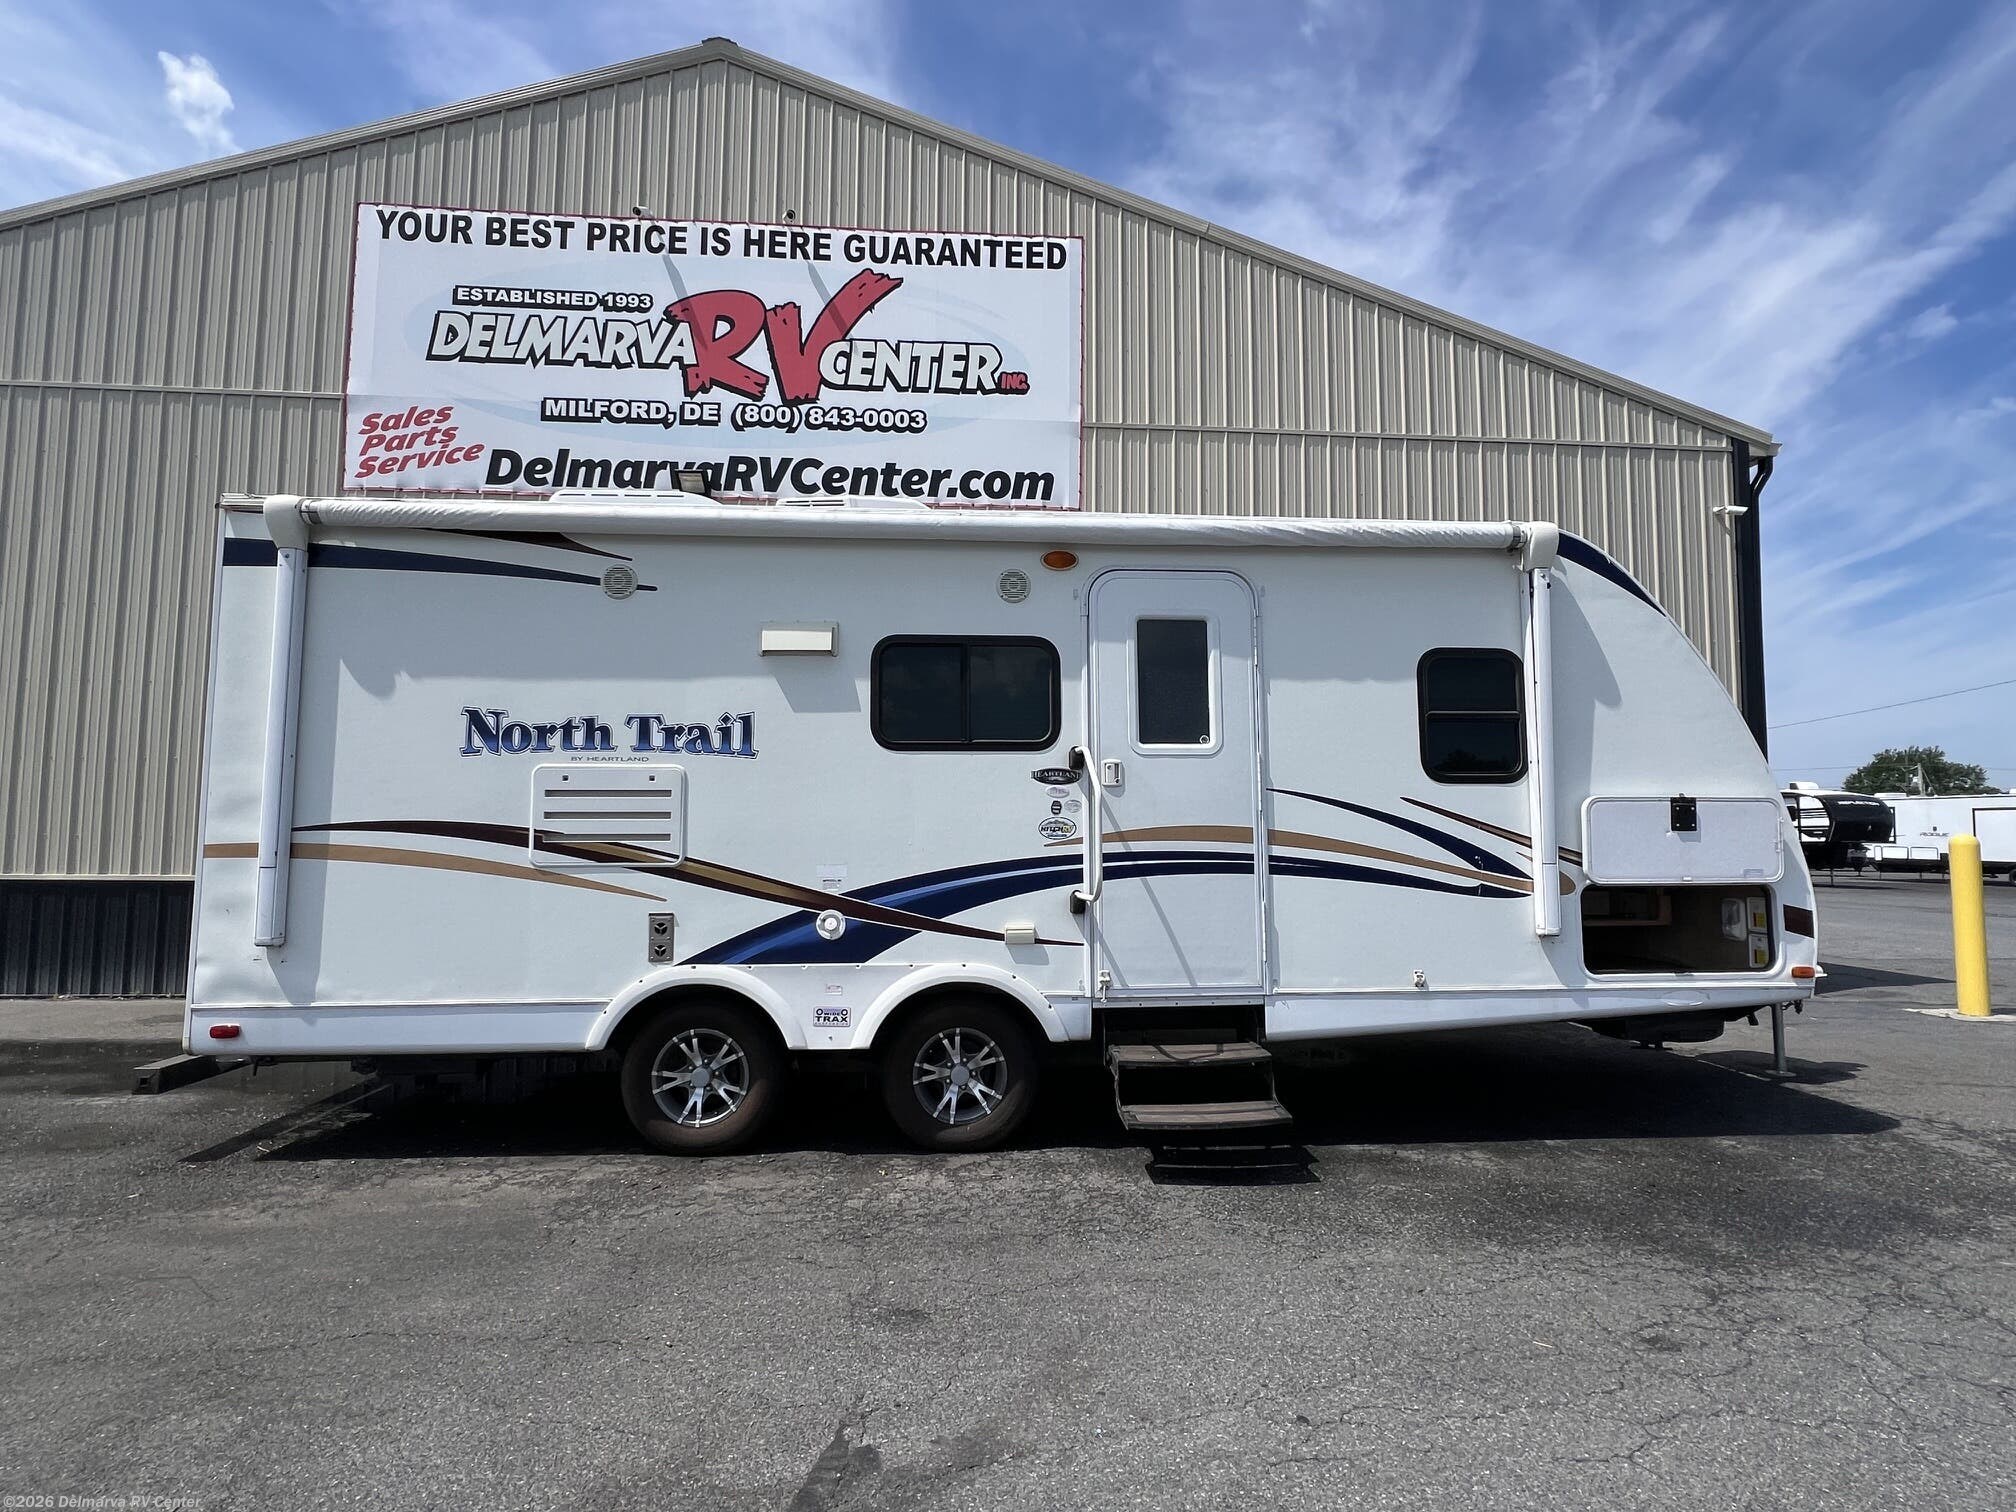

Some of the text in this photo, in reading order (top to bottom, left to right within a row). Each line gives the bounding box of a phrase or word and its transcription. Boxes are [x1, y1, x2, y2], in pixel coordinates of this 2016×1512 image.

[376, 209, 1067, 270] YOUR BEST PRICE IS HERE GUARANTEED
[455, 286, 653, 311] ESTABLISHED 1993
[426, 310, 699, 370] DELMARVA
[663, 267, 904, 406] RV
[818, 338, 1004, 396] CENTER
[358, 405, 455, 435] Sales
[544, 398, 927, 433] MILFORD, DE (800) 843-0003
[359, 425, 459, 456] Parts
[354, 442, 487, 479] Service
[485, 448, 1055, 501] DelmarvaRVCenter.com
[460, 706, 760, 760] North Trail
[814, 1015, 848, 1023] TRAX
